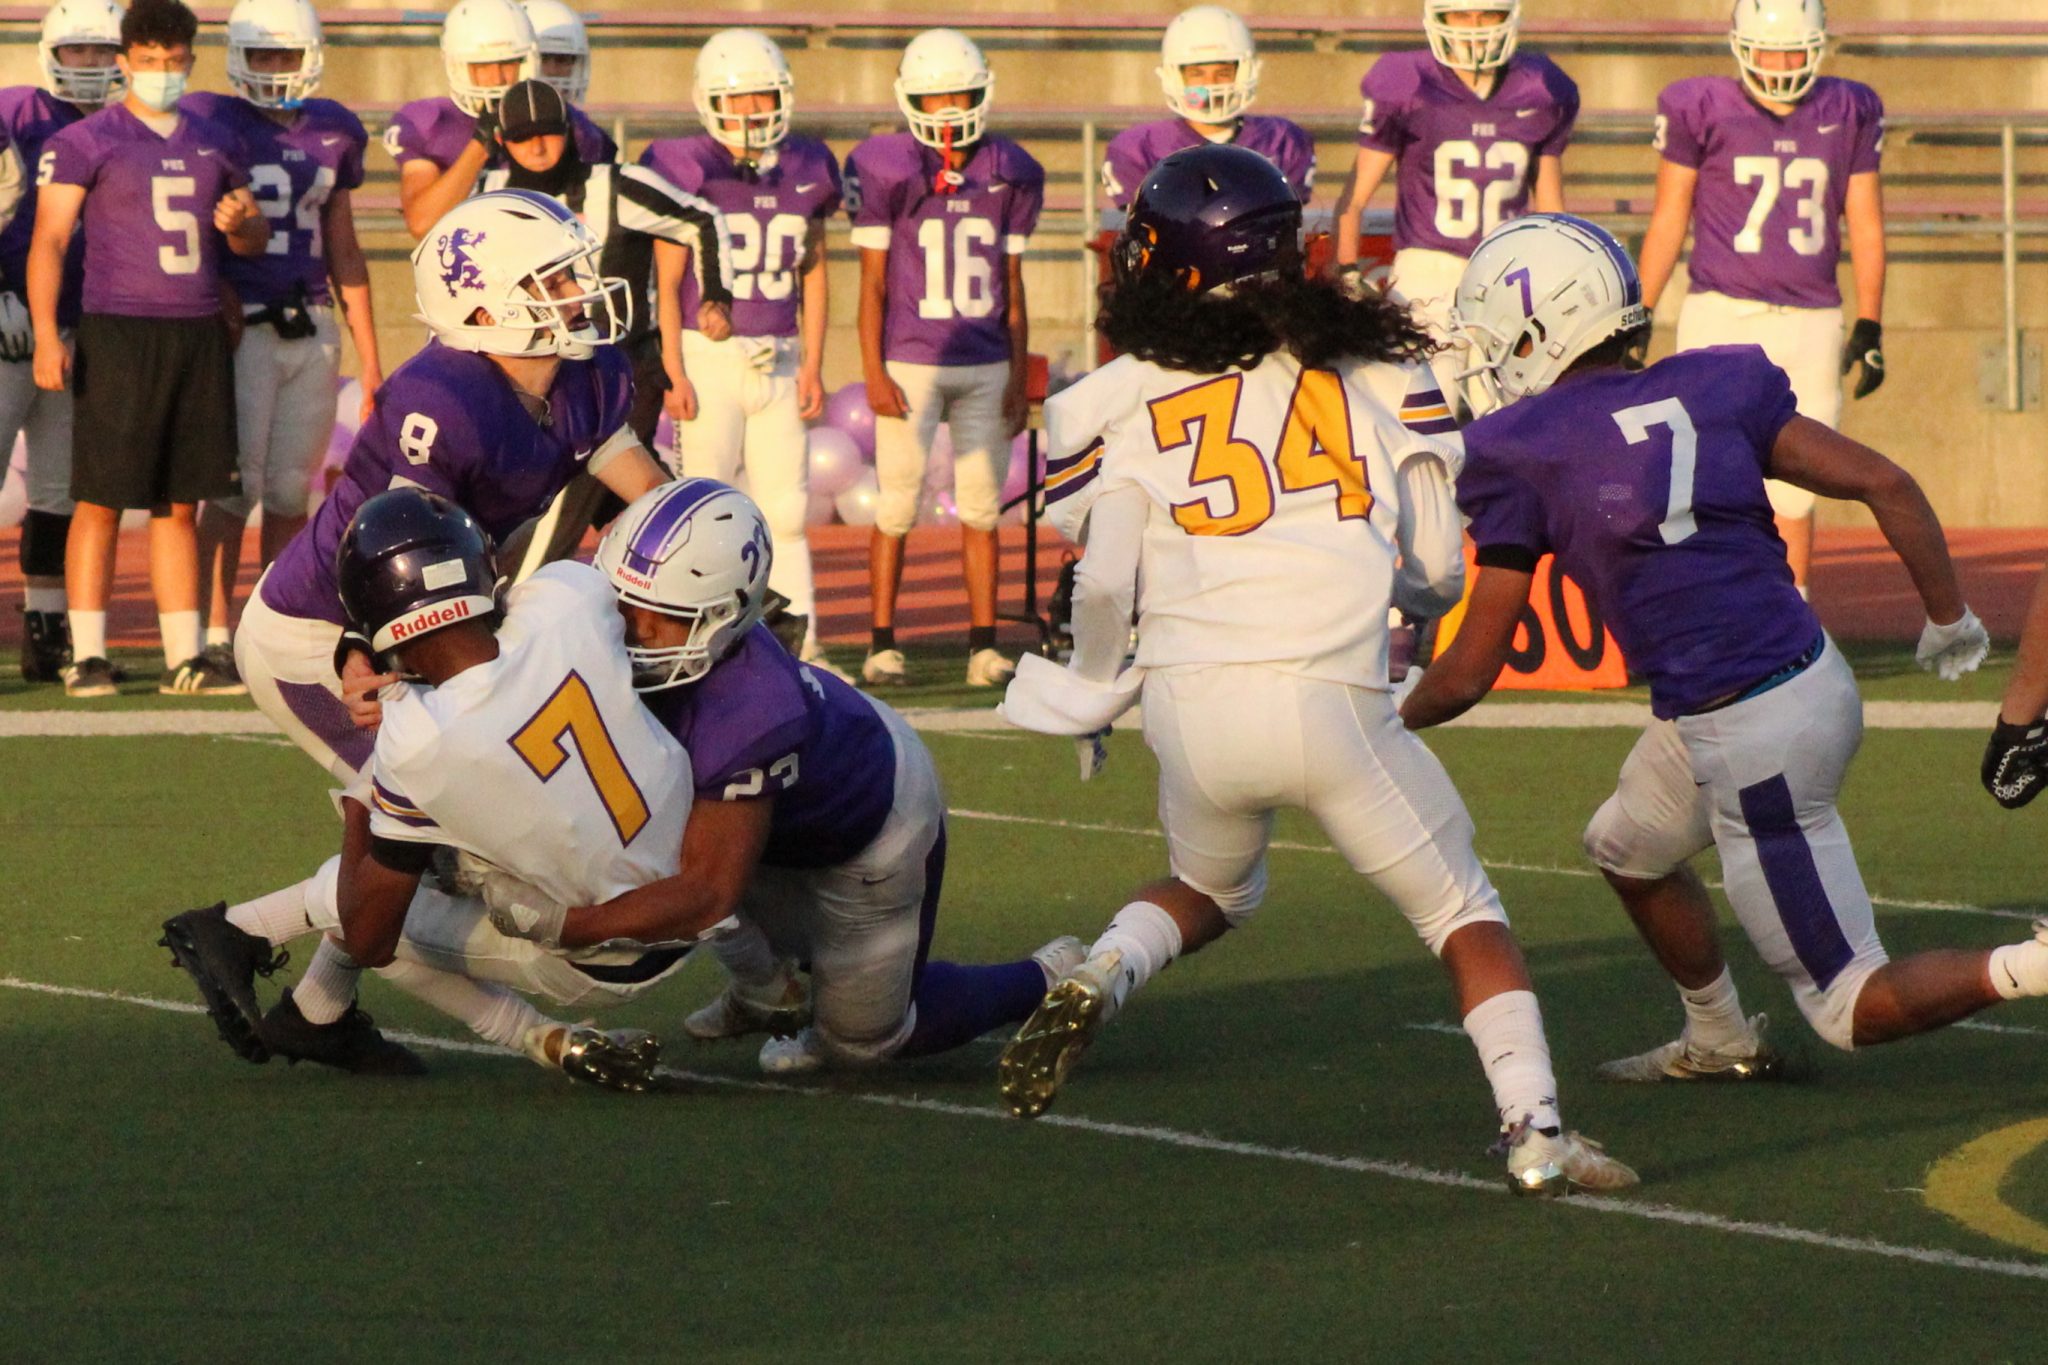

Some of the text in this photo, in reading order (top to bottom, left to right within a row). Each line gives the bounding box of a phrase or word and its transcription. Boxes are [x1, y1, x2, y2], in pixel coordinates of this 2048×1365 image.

[152, 176, 200, 275] 5
[248, 164, 338, 259] 24
[1434, 140, 1528, 239] 62
[1733, 156, 1829, 256] 73
[726, 212, 809, 300] 20
[918, 216, 996, 319] 16
[1504, 266, 1534, 318] 7
[398, 411, 438, 466] 8
[1146, 371, 1375, 537] 34
[1611, 396, 1698, 546] 7
[390, 600, 470, 641] Riddell
[616, 567, 652, 590] Riddell
[506, 668, 652, 849] 7
